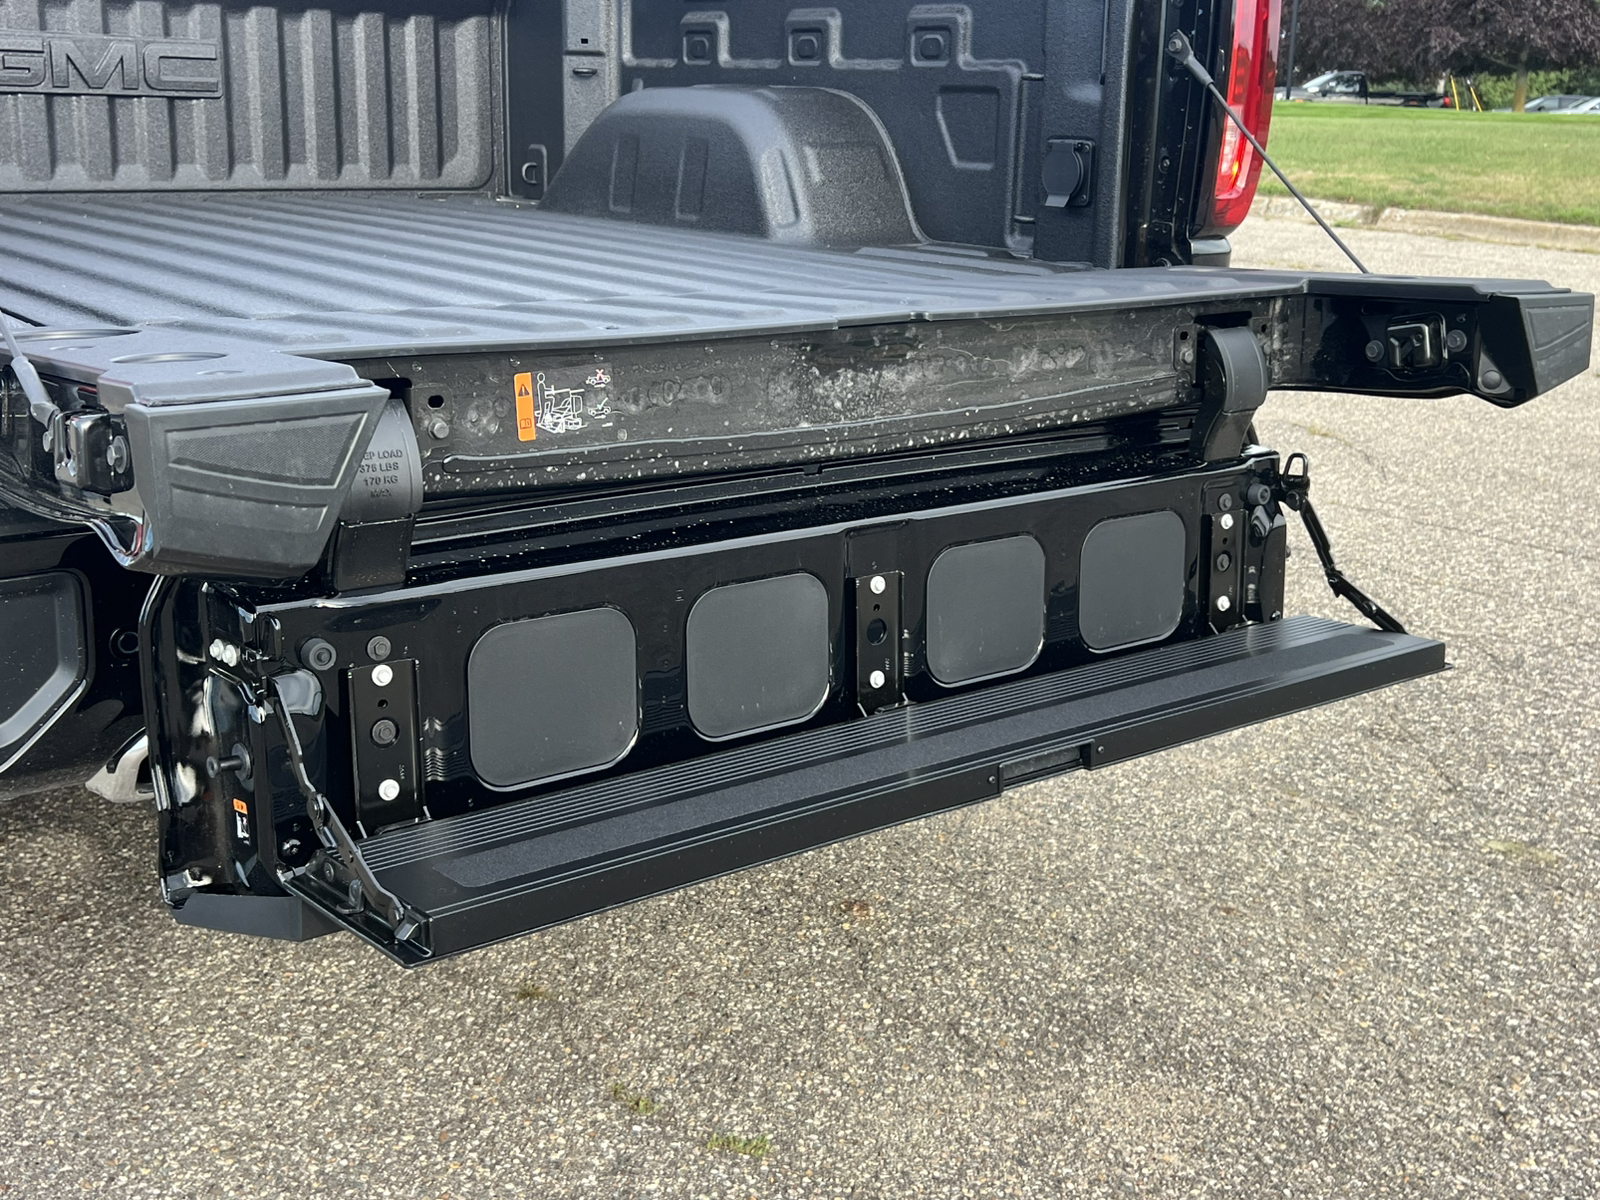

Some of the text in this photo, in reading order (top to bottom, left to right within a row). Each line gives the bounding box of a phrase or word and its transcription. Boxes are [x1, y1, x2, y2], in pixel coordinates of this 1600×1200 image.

[0, 38, 219, 92] GMC
[363, 449, 403, 460] EP LOAD
[359, 461, 399, 473] 375 LBS
[363, 474, 398, 486] 170 KG
